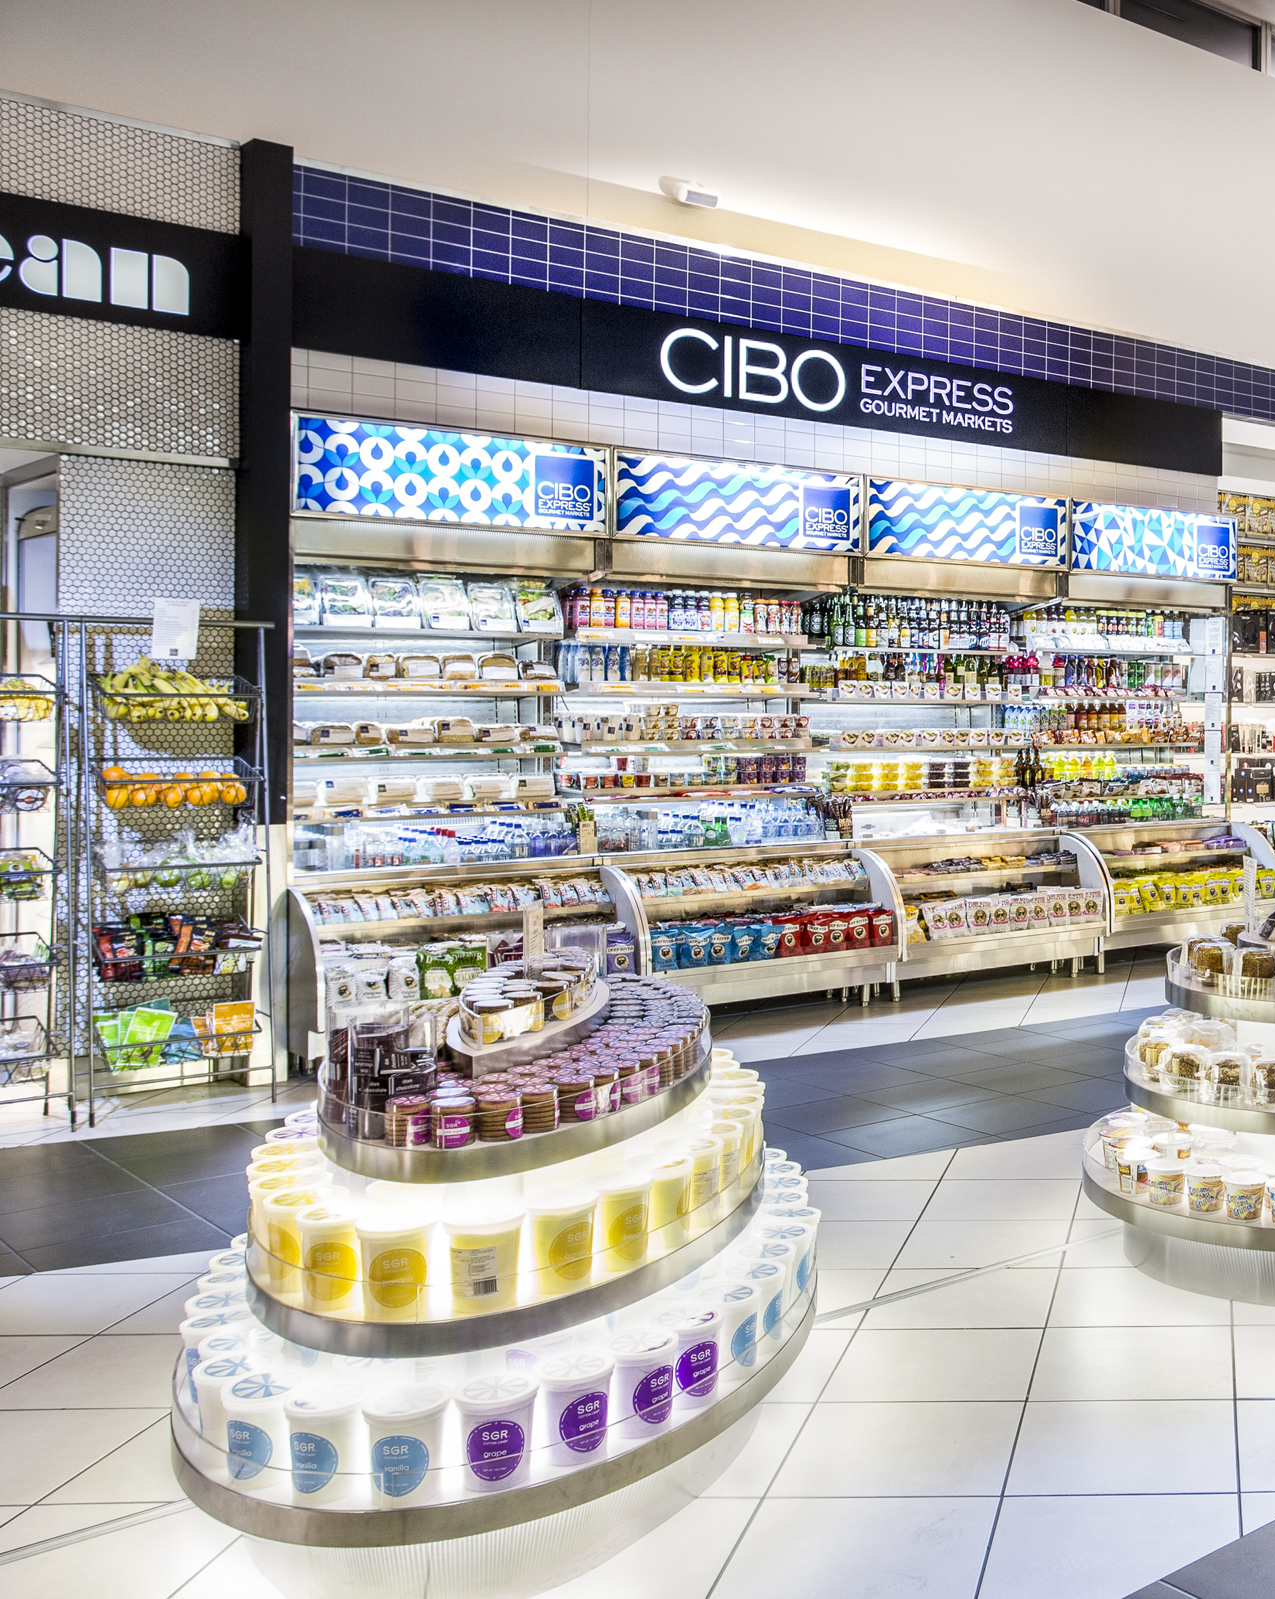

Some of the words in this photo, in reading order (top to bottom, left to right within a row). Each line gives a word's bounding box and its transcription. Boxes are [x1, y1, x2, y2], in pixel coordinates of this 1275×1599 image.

[0, 233, 190, 316] an
[660, 327, 846, 412] CIBO
[860, 363, 1014, 416] EXPRESS
[859, 397, 940, 424] GOURMET
[942, 411, 1013, 434] MARKETS
[537, 481, 591, 502] CIBO
[538, 499, 590, 512] EXPRESS
[805, 506, 848, 524] CIBO
[1021, 526, 1056, 543] CIBO
[1198, 543, 1228, 558] CIBO
[1189, 1186, 1215, 1197] Cinnamon
[1194, 1195, 1215, 1210] Crunch
[1227, 1193, 1252, 1204] Cinnamon
[1232, 1203, 1253, 1218] Crunch
[567, 1230, 588, 1243] SGR
[315, 1252, 340, 1262] SGR
[382, 1257, 409, 1270] SGR
[382, 1275, 414, 1287] banana
[690, 1348, 711, 1363] SGR
[693, 1366, 711, 1378] grape
[650, 1373, 669, 1388] SGR
[652, 1391, 669, 1404] grape
[577, 1400, 600, 1415] SGR
[579, 1419, 600, 1431] grape
[229, 1428, 250, 1440] SGR
[482, 1429, 509, 1441] SGR
[293, 1441, 316, 1452] SGR
[383, 1445, 409, 1456] SGR
[483, 1449, 508, 1459] grape
[295, 1461, 317, 1470] vanilla
[383, 1464, 410, 1473] vanilla
